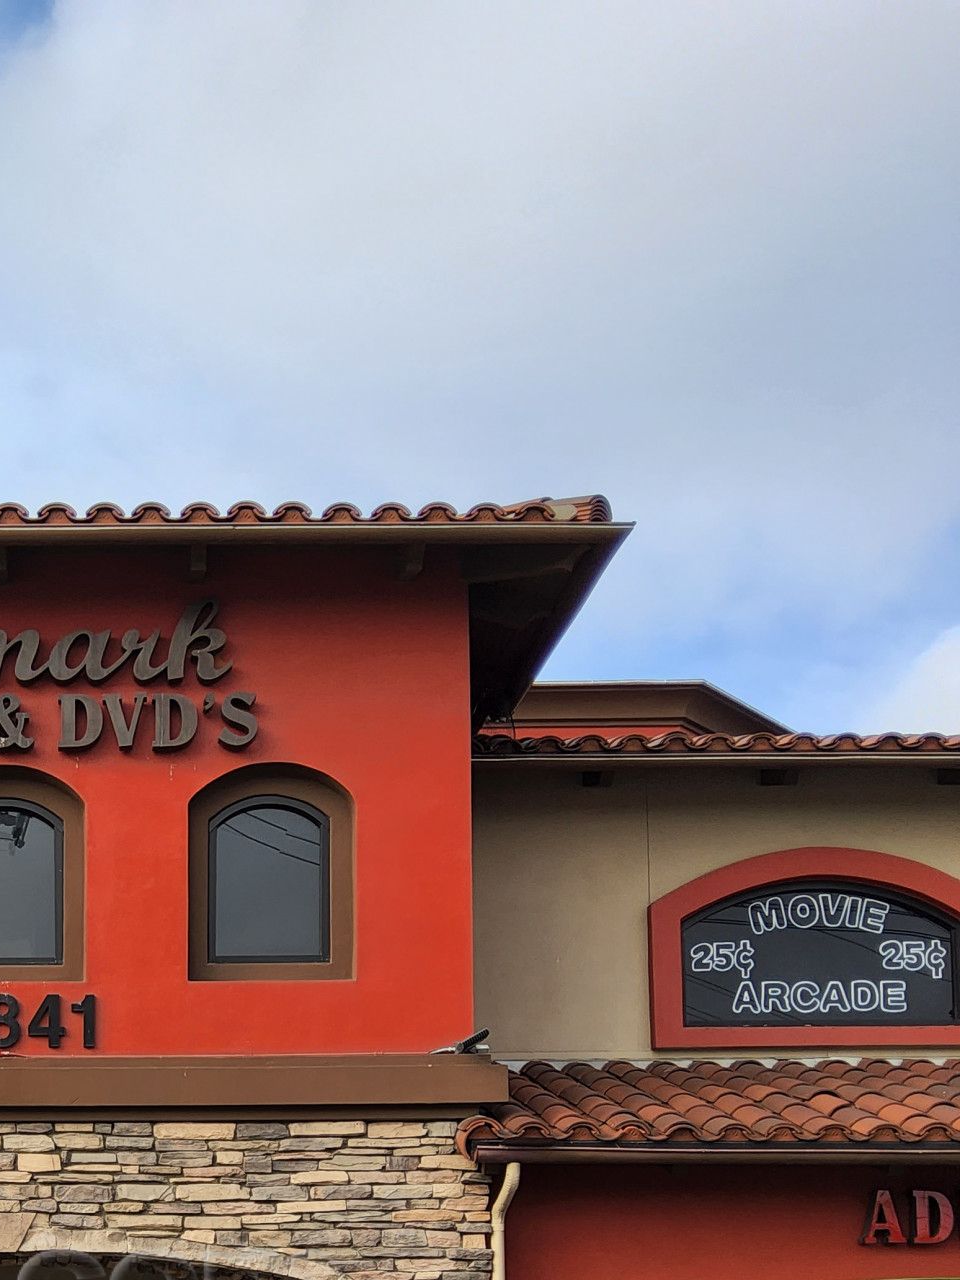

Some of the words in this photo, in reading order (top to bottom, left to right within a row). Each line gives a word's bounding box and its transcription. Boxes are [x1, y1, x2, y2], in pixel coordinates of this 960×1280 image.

[57, 691, 260, 751] DVD'S
[748, 894, 890, 935] MOVIE
[690, 940, 755, 978] 25¢
[878, 940, 946, 979] 25¢
[732, 980, 908, 1014] ARCADE
[864, 1190, 955, 1244] AD
